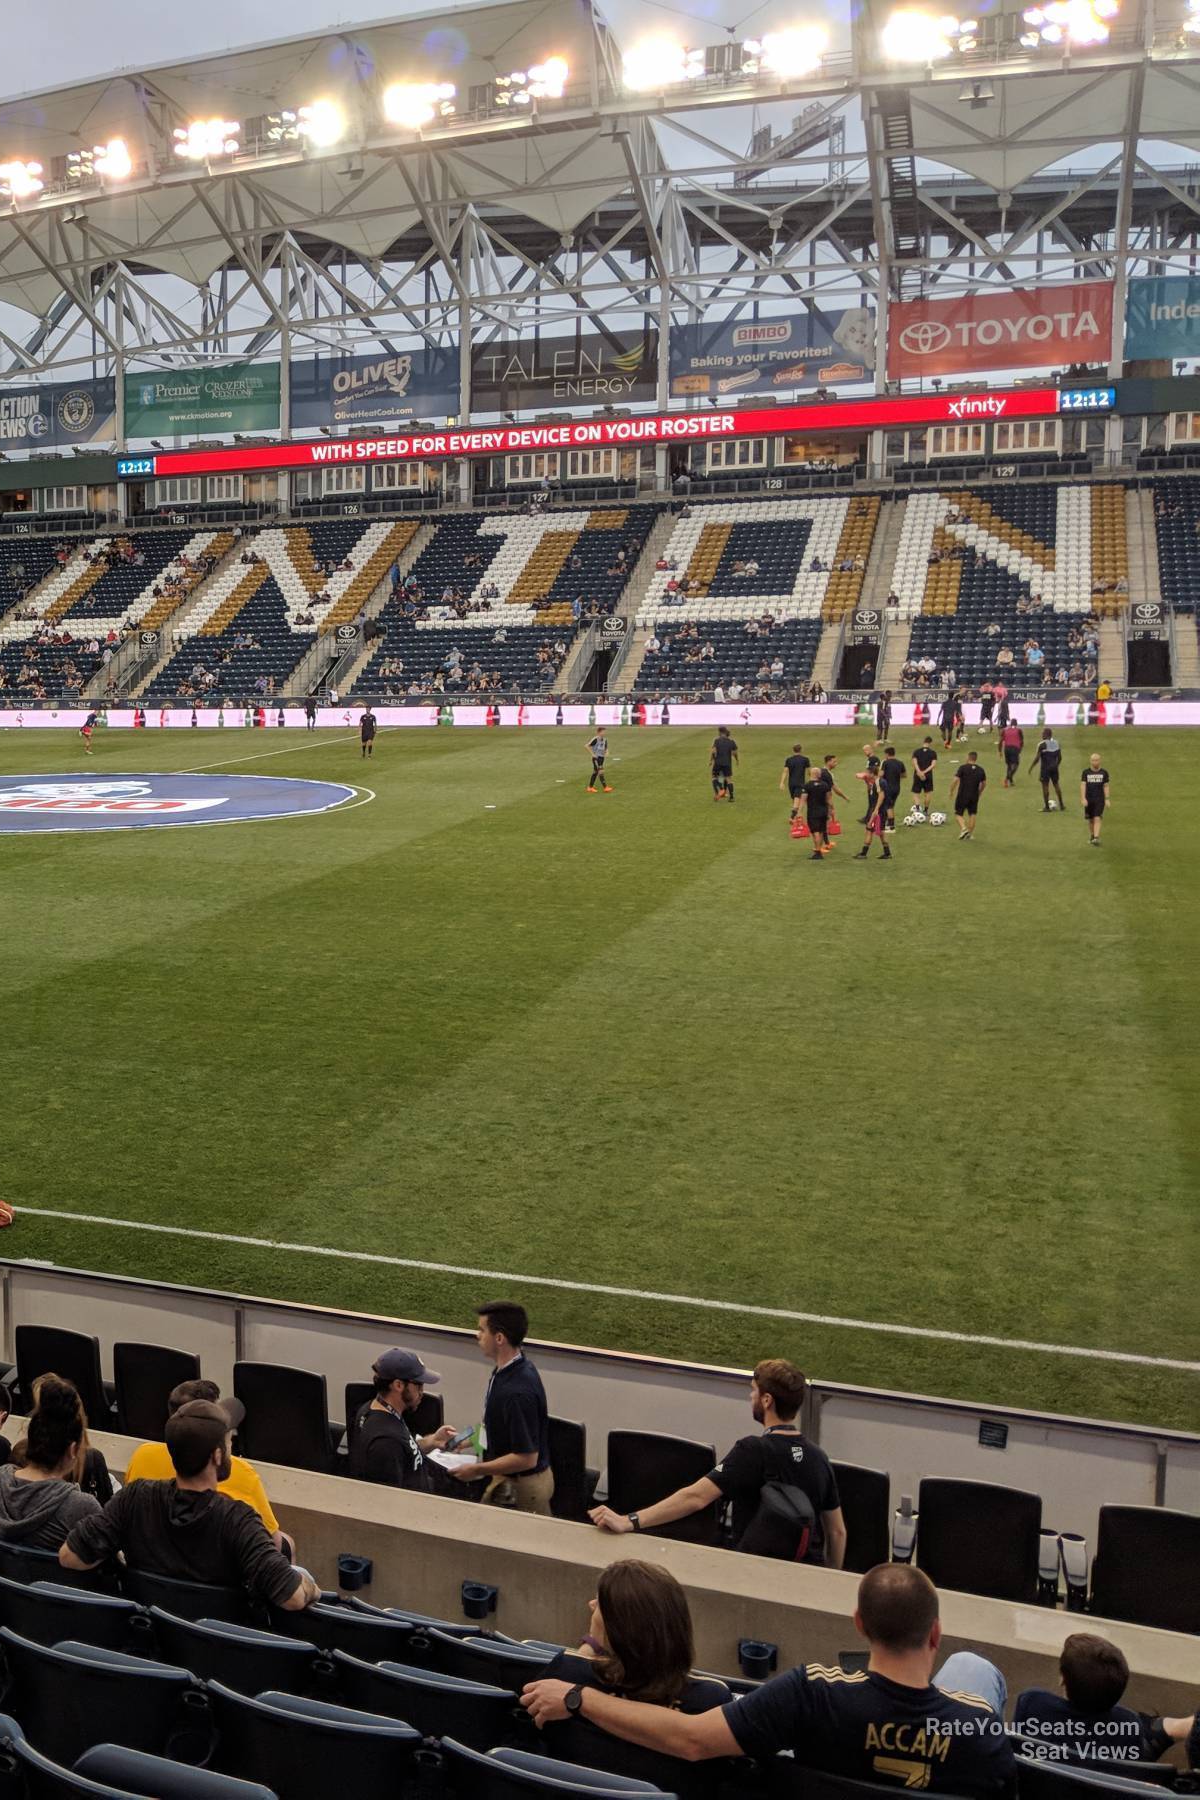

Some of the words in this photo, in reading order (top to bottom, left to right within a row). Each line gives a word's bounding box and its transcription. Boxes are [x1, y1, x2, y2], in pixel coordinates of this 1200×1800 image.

[737, 326, 788, 341] BIMBO
[955, 311, 1100, 346] TOYOTA
[690, 355, 733, 368] Baking
[737, 353, 765, 366] your
[768, 346, 832, 360] Favorites!
[482, 348, 602, 383] TALEN
[333, 355, 412, 392] OLIVER
[155, 383, 200, 397] Premier
[553, 376, 638, 398] ENERGY
[948, 397, 1007, 418] xfinity
[1062, 392, 1109, 408] 12:12
[311, 444, 352, 460] WITH
[356, 440, 409, 457] SPEED
[413, 437, 445, 452] FOR
[450, 432, 503, 450] EVERY
[508, 427, 570, 446] DEVICE
[574, 425, 601, 441] ON
[605, 421, 657, 439] YOUR
[661, 415, 735, 434] ROSTER
[120, 461, 152, 474] 12:12
[996, 467, 1014, 477] 129
[765, 479, 782, 489] 128
[533, 493, 548, 502] 127
[344, 505, 358, 514] 126
[172, 516, 184, 524] 125
[16, 525, 28, 533] 124
[865, 1722, 952, 1763] ACCAM
